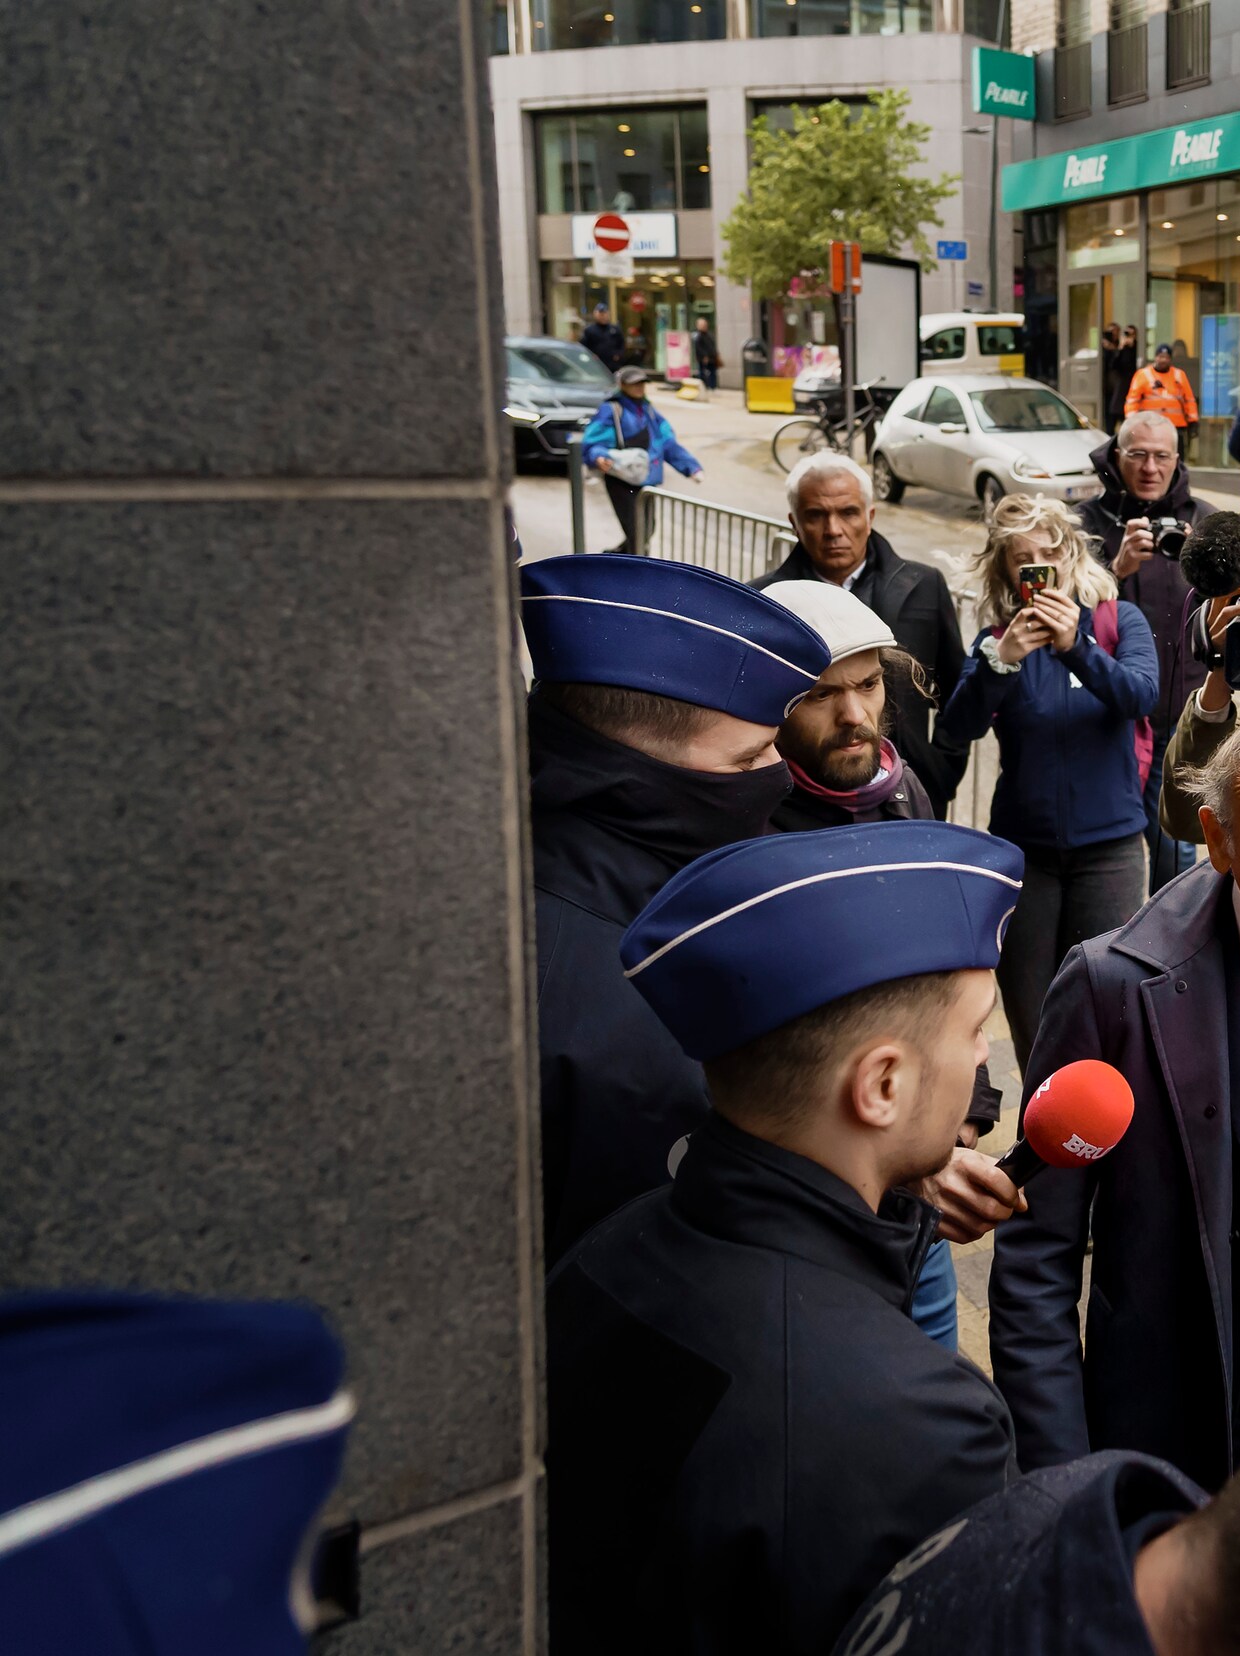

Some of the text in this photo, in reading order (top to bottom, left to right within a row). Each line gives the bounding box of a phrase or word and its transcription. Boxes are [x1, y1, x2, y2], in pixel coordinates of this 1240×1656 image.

[984, 81, 1029, 107] PEARLE
[1170, 129, 1223, 167] PEARLE
[1063, 154, 1108, 188] PEARLE
